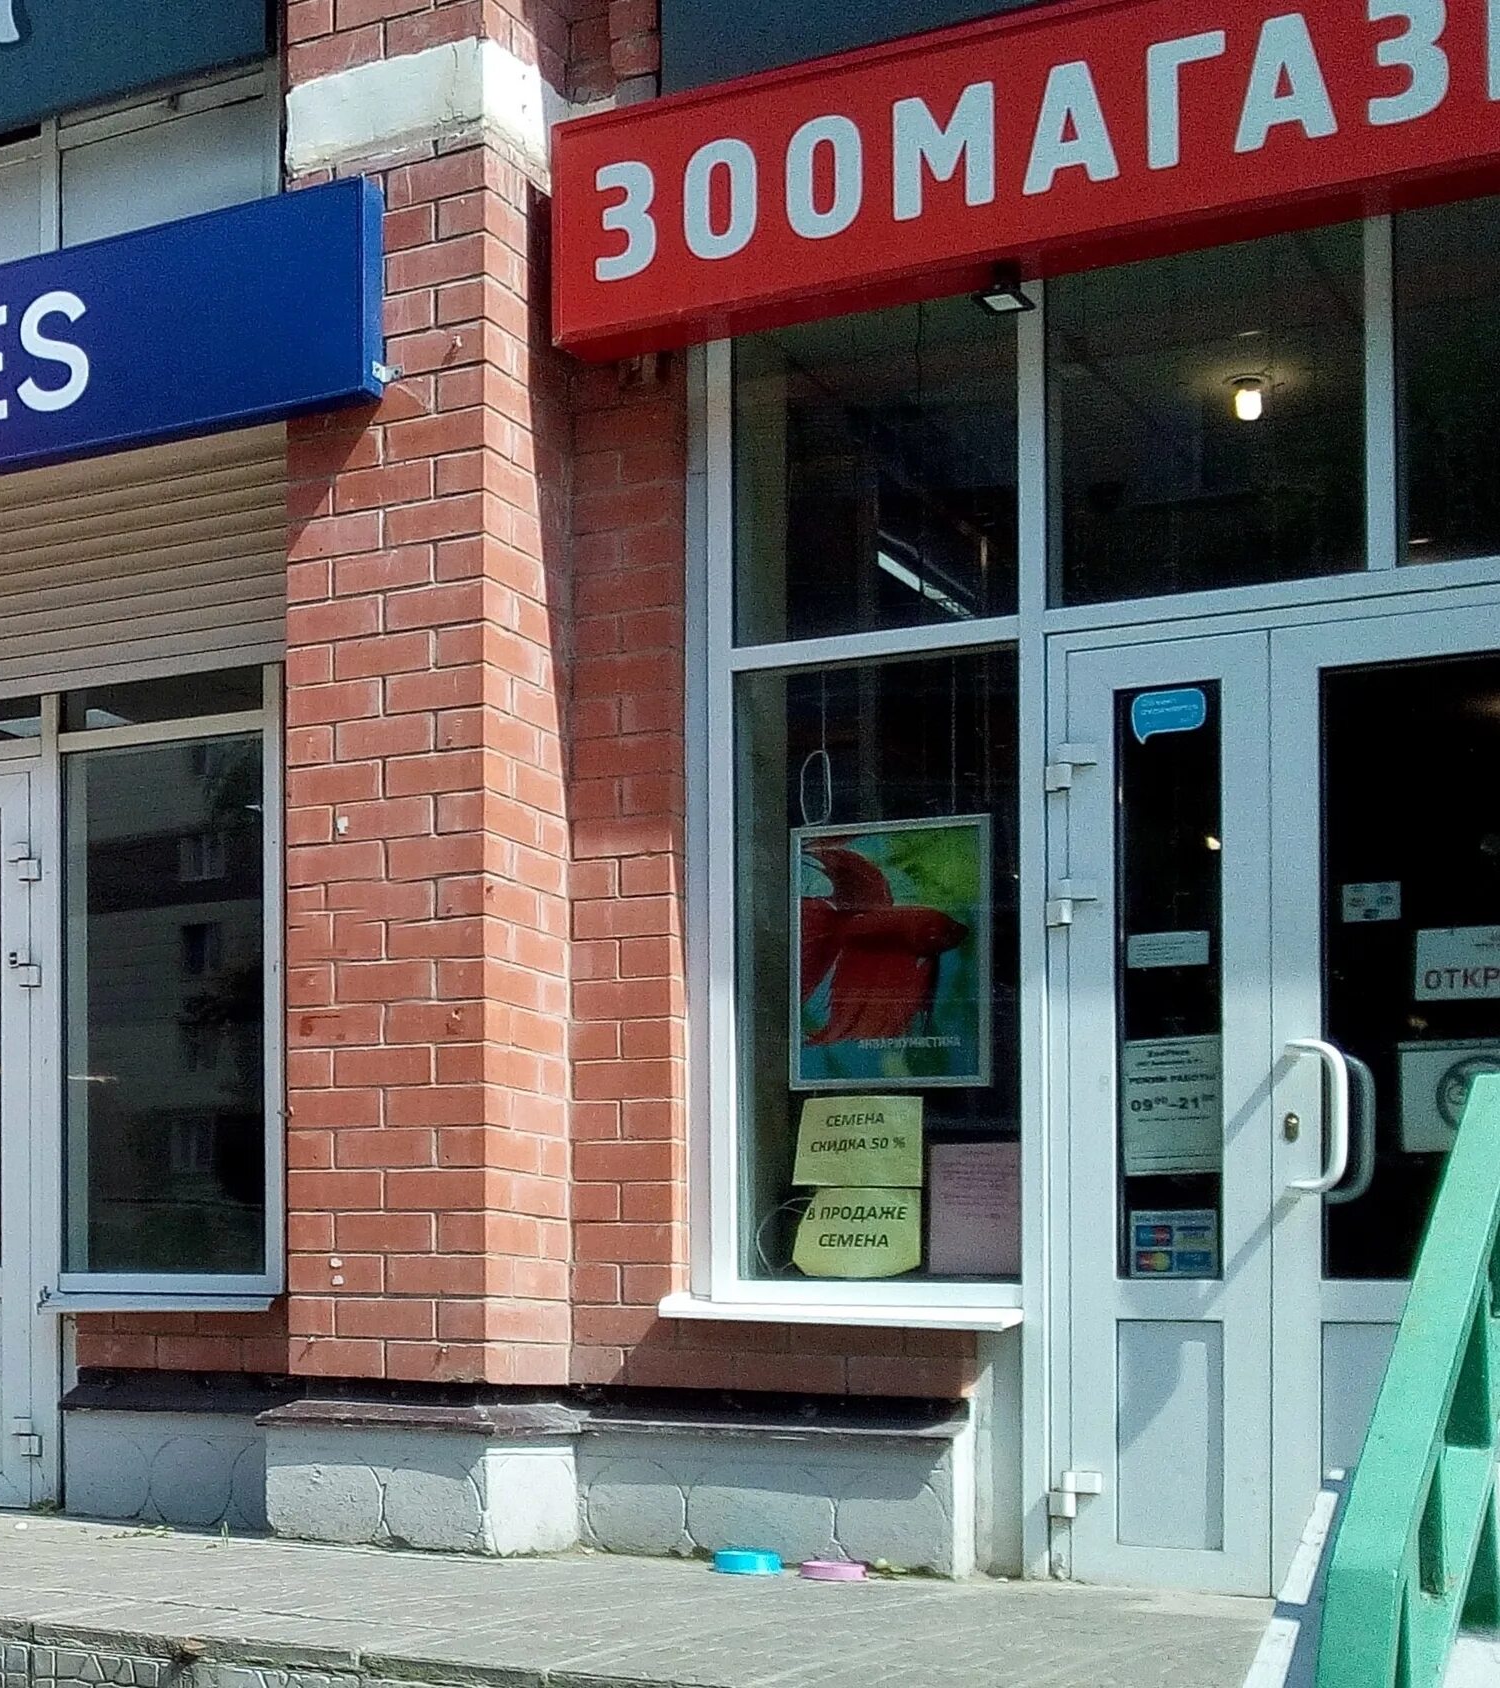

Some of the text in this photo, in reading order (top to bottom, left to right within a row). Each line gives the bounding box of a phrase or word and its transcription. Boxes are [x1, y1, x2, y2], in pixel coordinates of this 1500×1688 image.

[594, 0, 1500, 284] ЗООМАГАЗ
[826, 1112, 885, 1128] СЕМЕНА
[810, 1136, 906, 1154] СКИДКА 50 %
[806, 1206, 909, 1223] В ПРОДАЖЕ
[818, 1233, 889, 1248] СЕМЕНА
